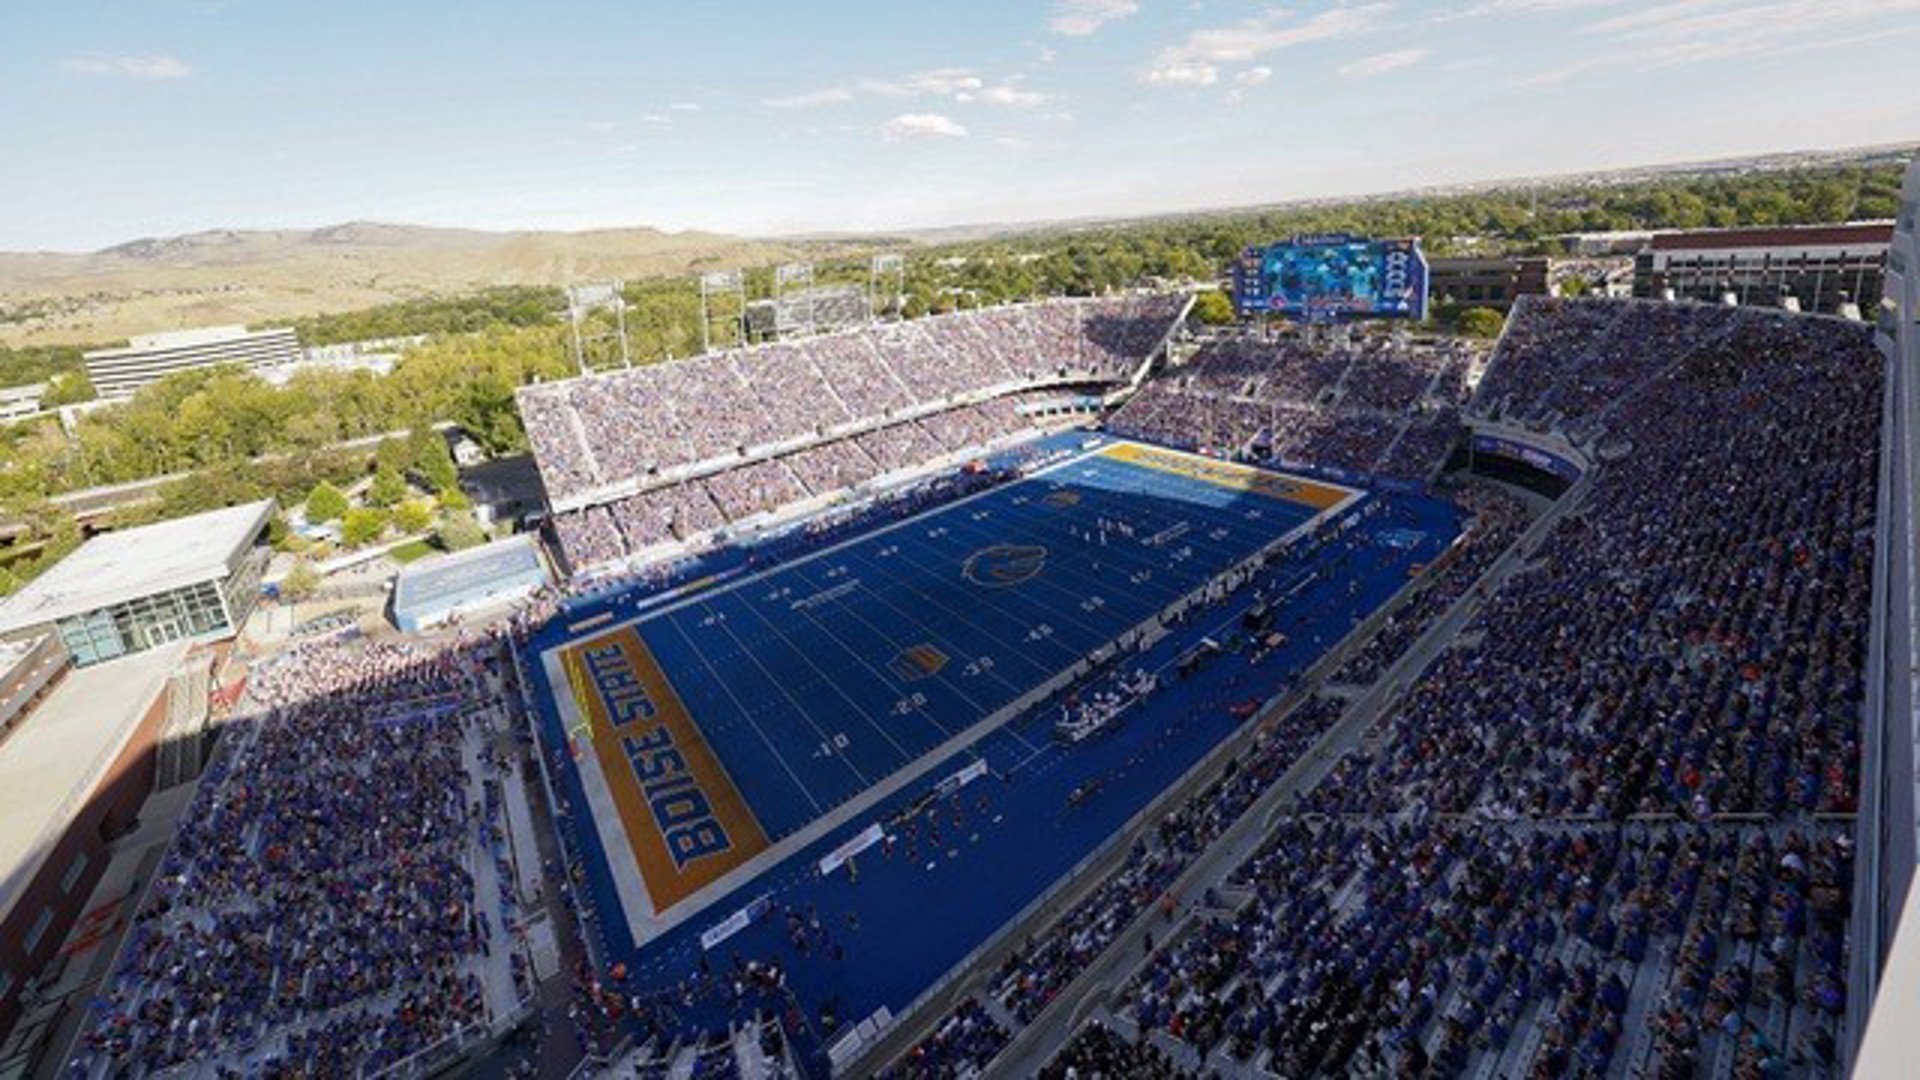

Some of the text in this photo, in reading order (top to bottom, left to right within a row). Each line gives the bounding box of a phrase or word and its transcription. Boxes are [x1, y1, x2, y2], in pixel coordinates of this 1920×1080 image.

[965, 656, 994, 676] 30
[582, 643, 658, 729] STATE
[899, 692, 926, 714] 20
[820, 732, 849, 756] 10
[621, 722, 735, 874] BOISE
